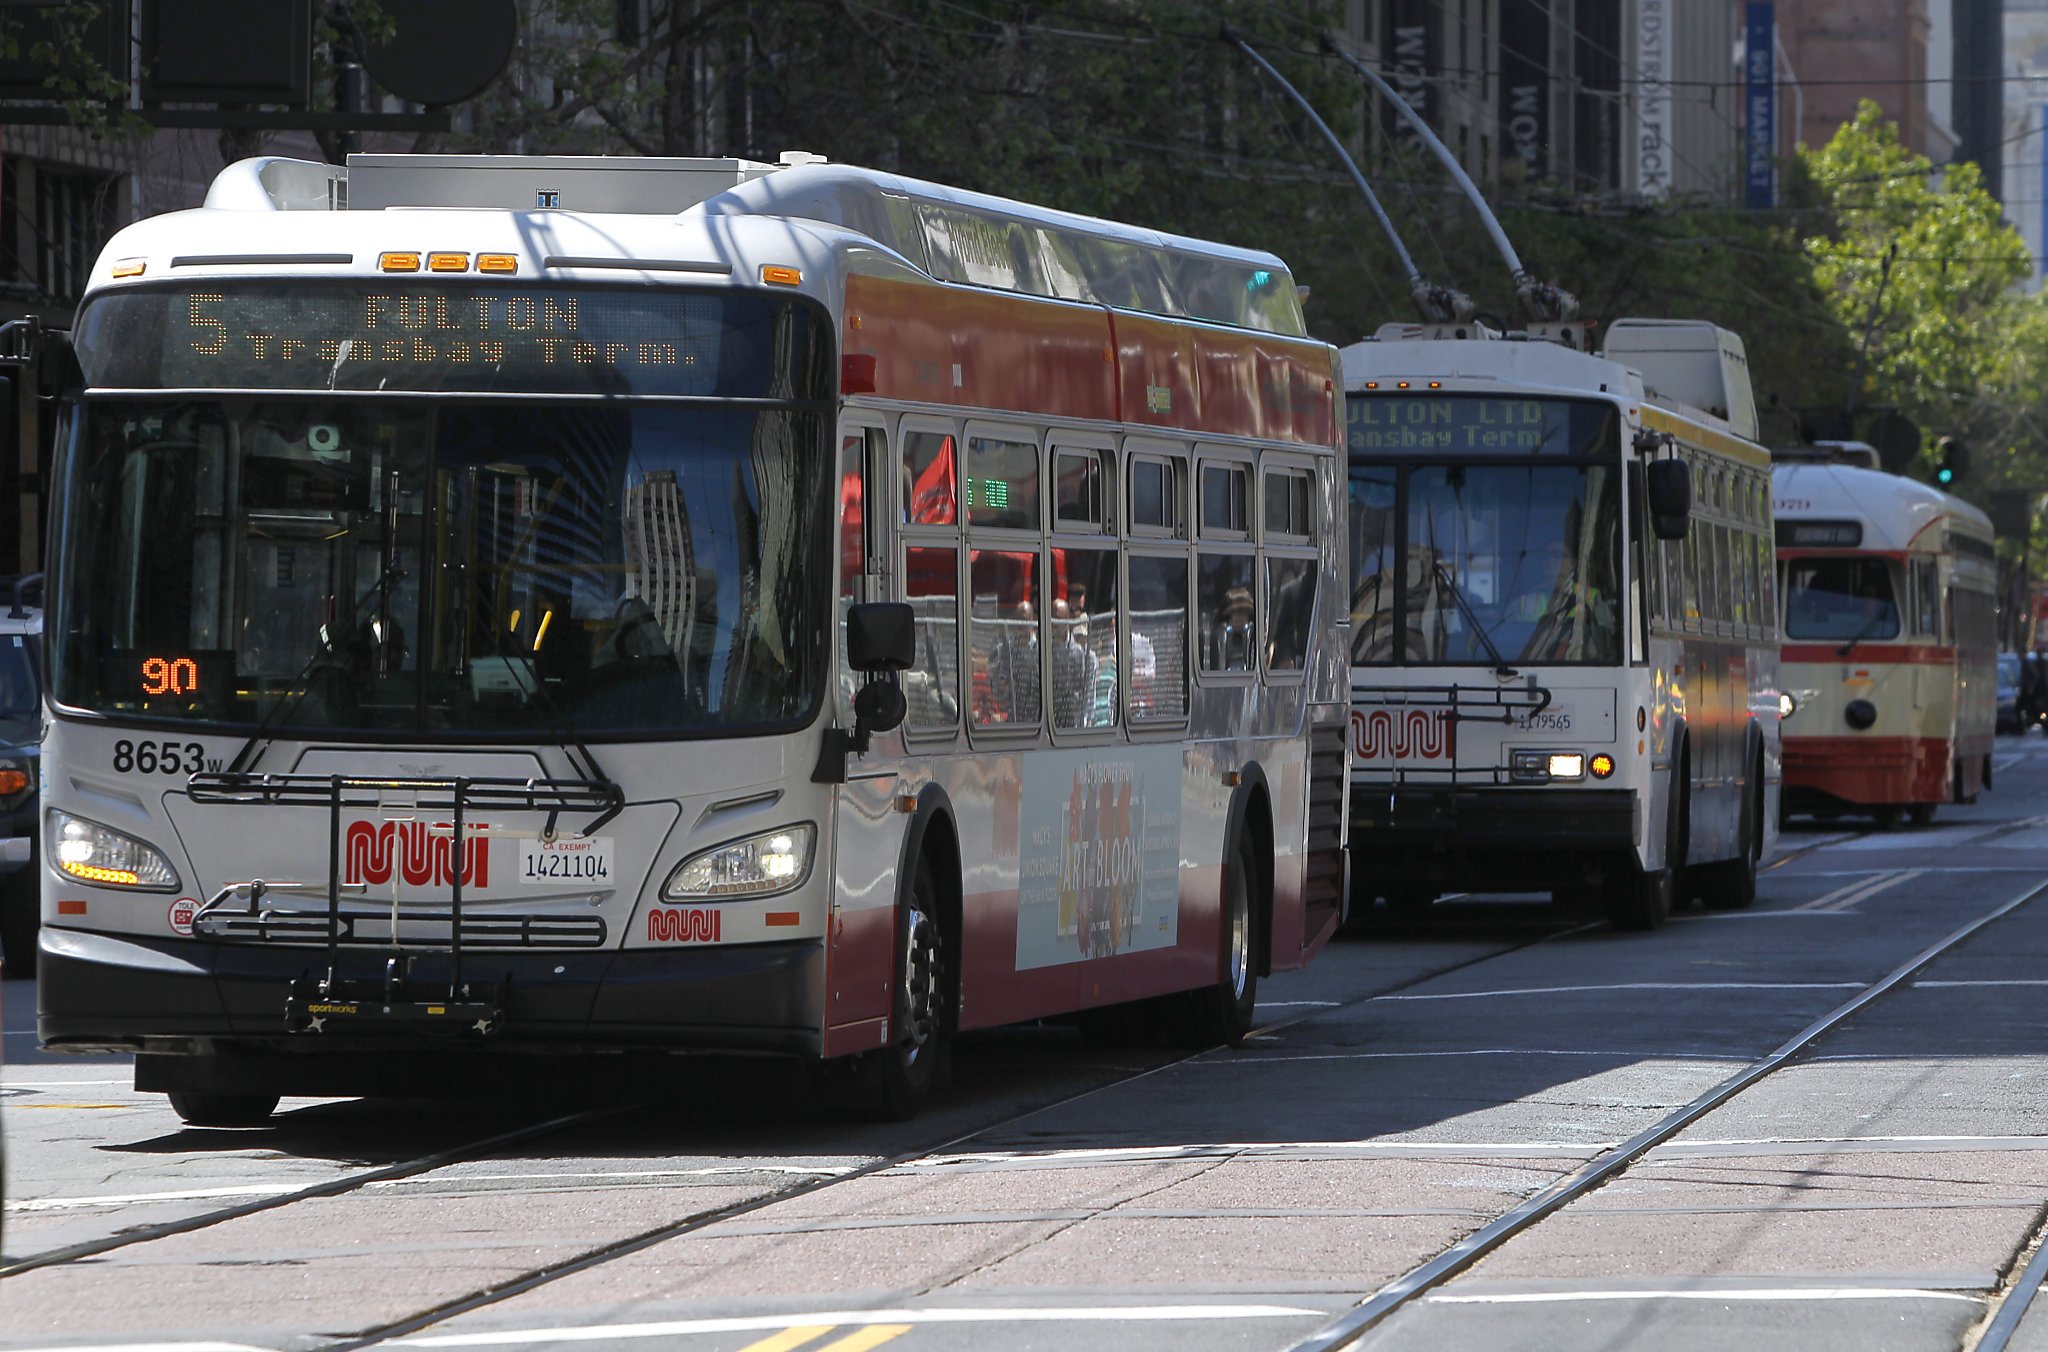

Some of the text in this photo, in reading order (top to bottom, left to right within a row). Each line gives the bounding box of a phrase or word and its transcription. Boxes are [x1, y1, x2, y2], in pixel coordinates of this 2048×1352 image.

[190, 293, 227, 356] 5
[367, 295, 577, 331] FULTON
[246, 335, 694, 365] Transbay Term.
[1479, 401, 1542, 425] LTD
[543, 843, 591, 851] CA EXEMPT
[526, 854, 607, 878] 1421104
[1063, 840, 1089, 892] ART
[1096, 836, 1141, 888] BLOOM
[308, 1004, 358, 1015] sportworks
